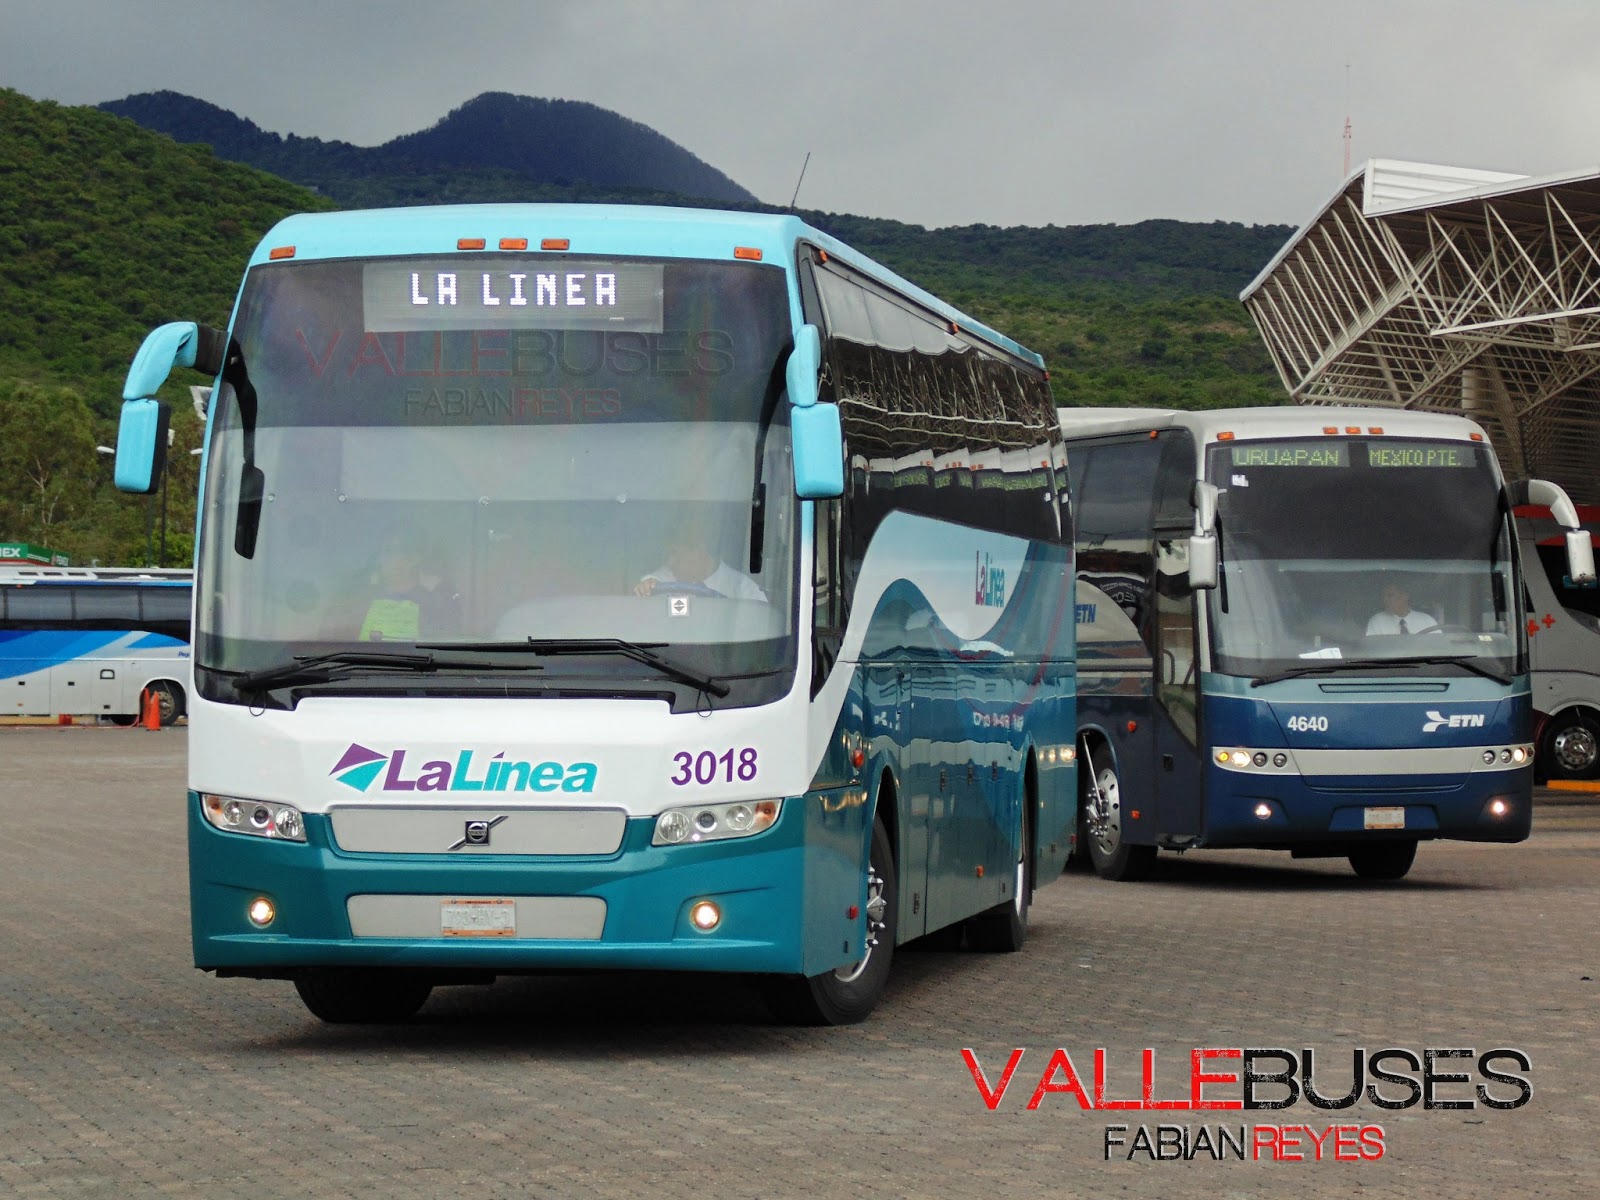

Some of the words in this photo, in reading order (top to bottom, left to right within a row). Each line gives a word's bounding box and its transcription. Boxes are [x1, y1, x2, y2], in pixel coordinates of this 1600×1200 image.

[411, 273, 457, 306] LA
[482, 273, 616, 306] LINEA
[1235, 449, 1339, 466] URUAPAN
[1369, 450, 1424, 467] MEXICO
[1427, 450, 1462, 466] PTE.
[0, 547, 21, 558] EX
[1287, 715, 1328, 732] 4640
[1448, 714, 1485, 728] ETN
[670, 747, 759, 787] 3018
